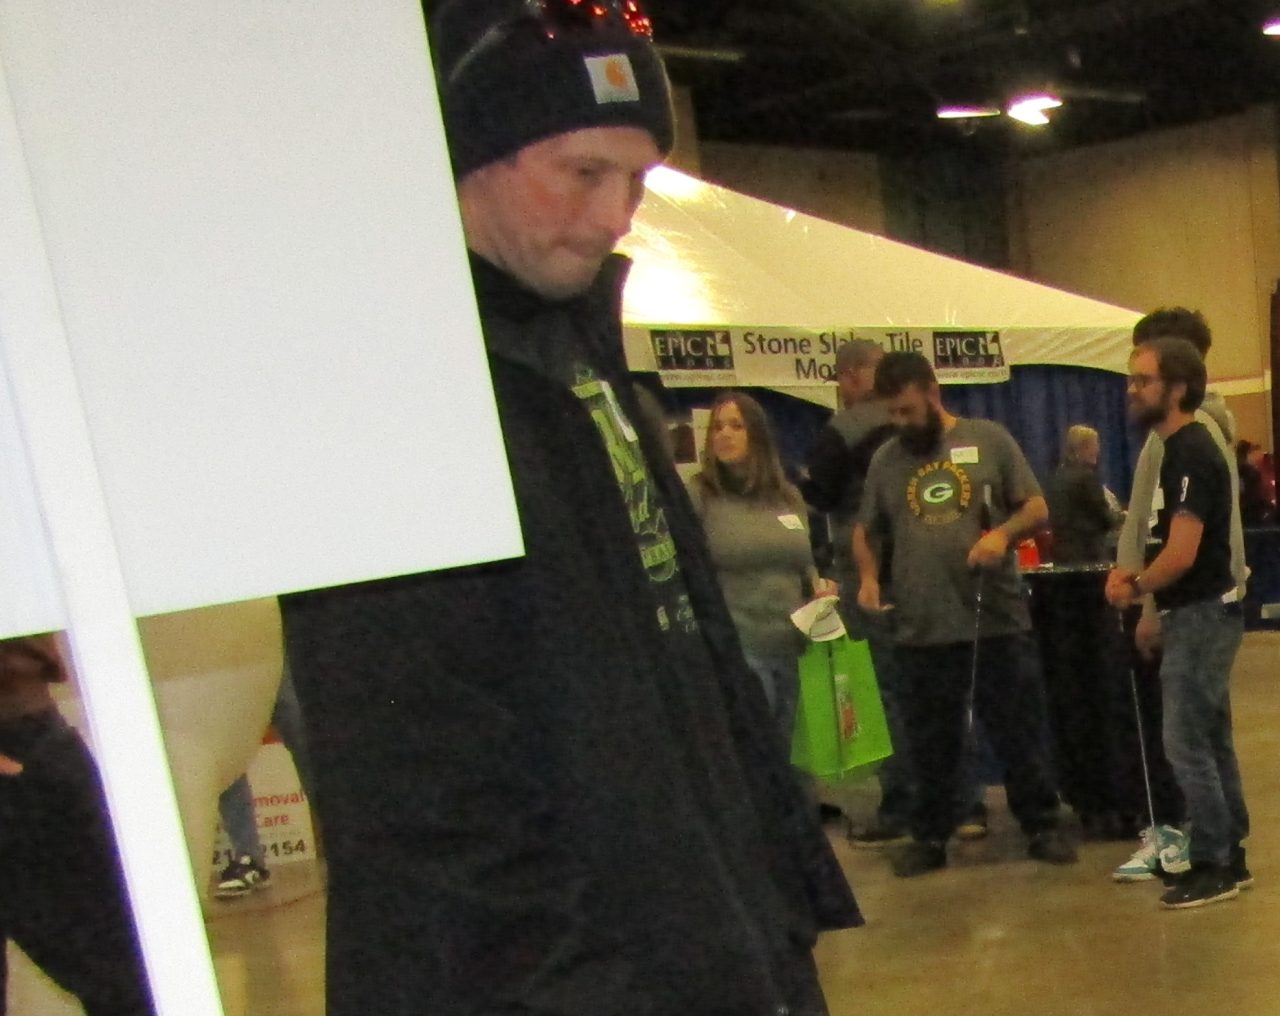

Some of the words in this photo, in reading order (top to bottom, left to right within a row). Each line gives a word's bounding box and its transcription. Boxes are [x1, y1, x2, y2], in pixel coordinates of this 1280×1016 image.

[743, 331, 811, 354] Stone
[885, 331, 923, 352] Tile
[936, 337, 977, 356] EPIC
